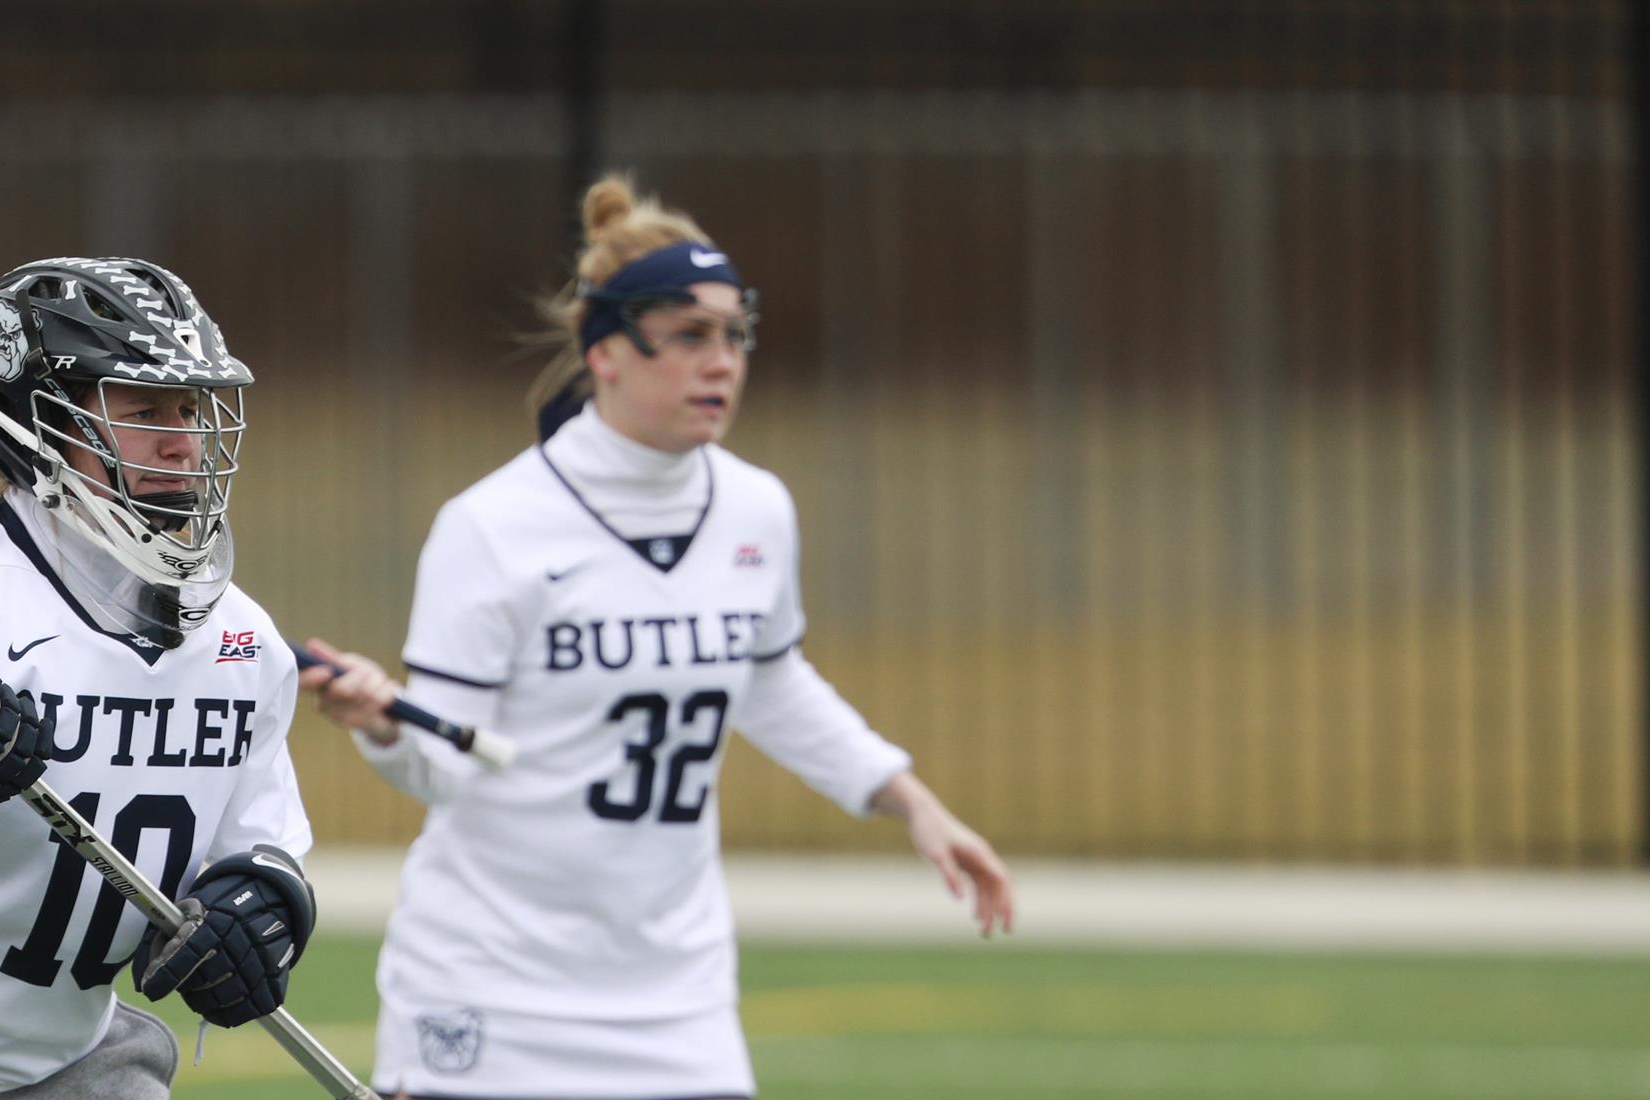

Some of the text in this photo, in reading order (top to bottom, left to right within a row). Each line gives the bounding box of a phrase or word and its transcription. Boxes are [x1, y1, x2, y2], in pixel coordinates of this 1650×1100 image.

[16, 689, 257, 768] UTLER
[587, 689, 729, 823] 32
[91, 856, 139, 897] STALLION
